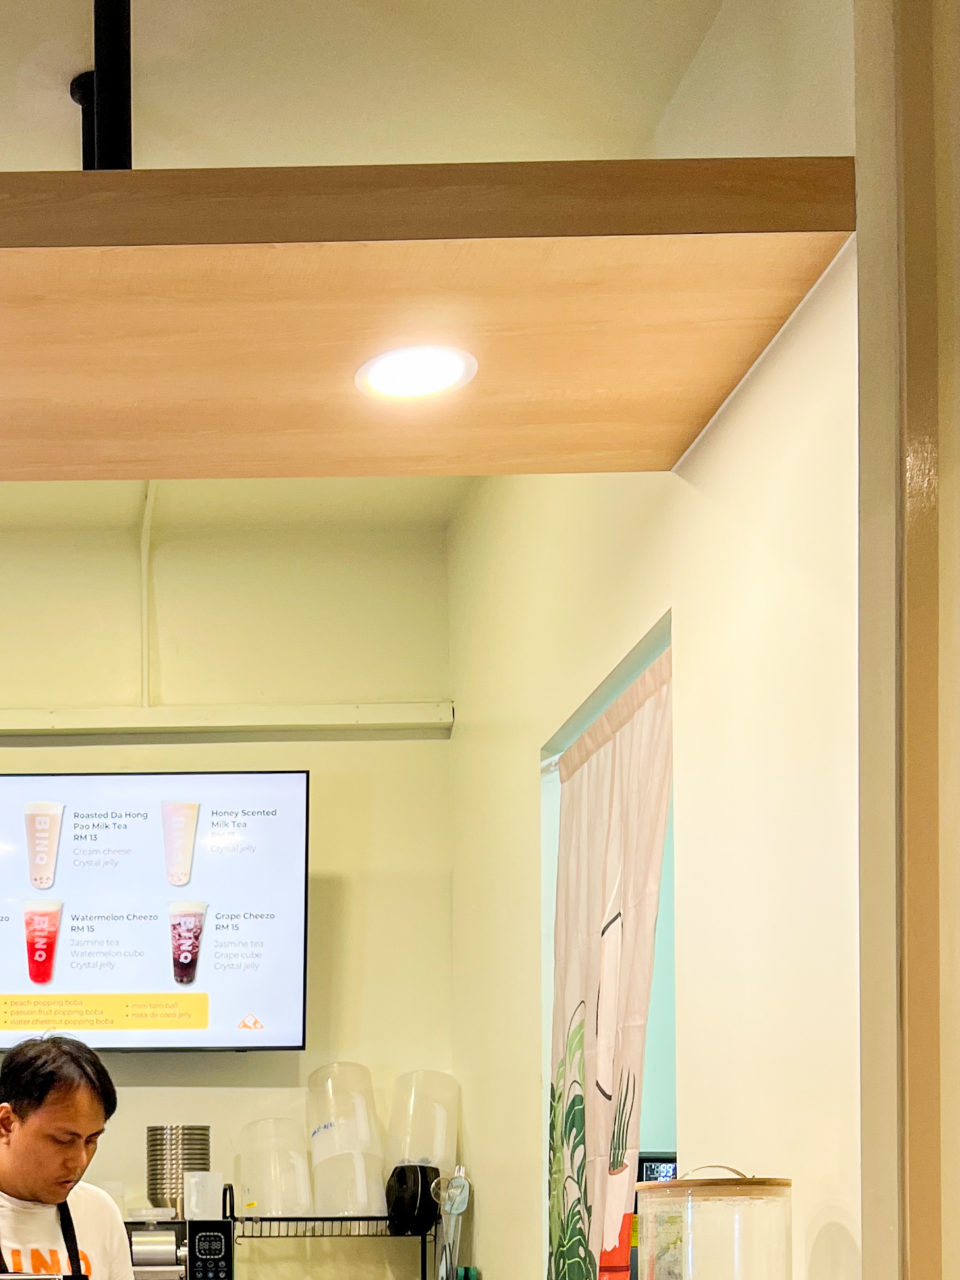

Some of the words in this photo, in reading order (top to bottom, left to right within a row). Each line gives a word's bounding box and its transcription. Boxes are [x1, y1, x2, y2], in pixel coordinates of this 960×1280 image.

[125, 812, 148, 820] Hong
[211, 810, 239, 818] Honey
[35, 817, 50, 864] BINQ
[34, 916, 48, 962] BINQ
[179, 917, 195, 963] BINQ
